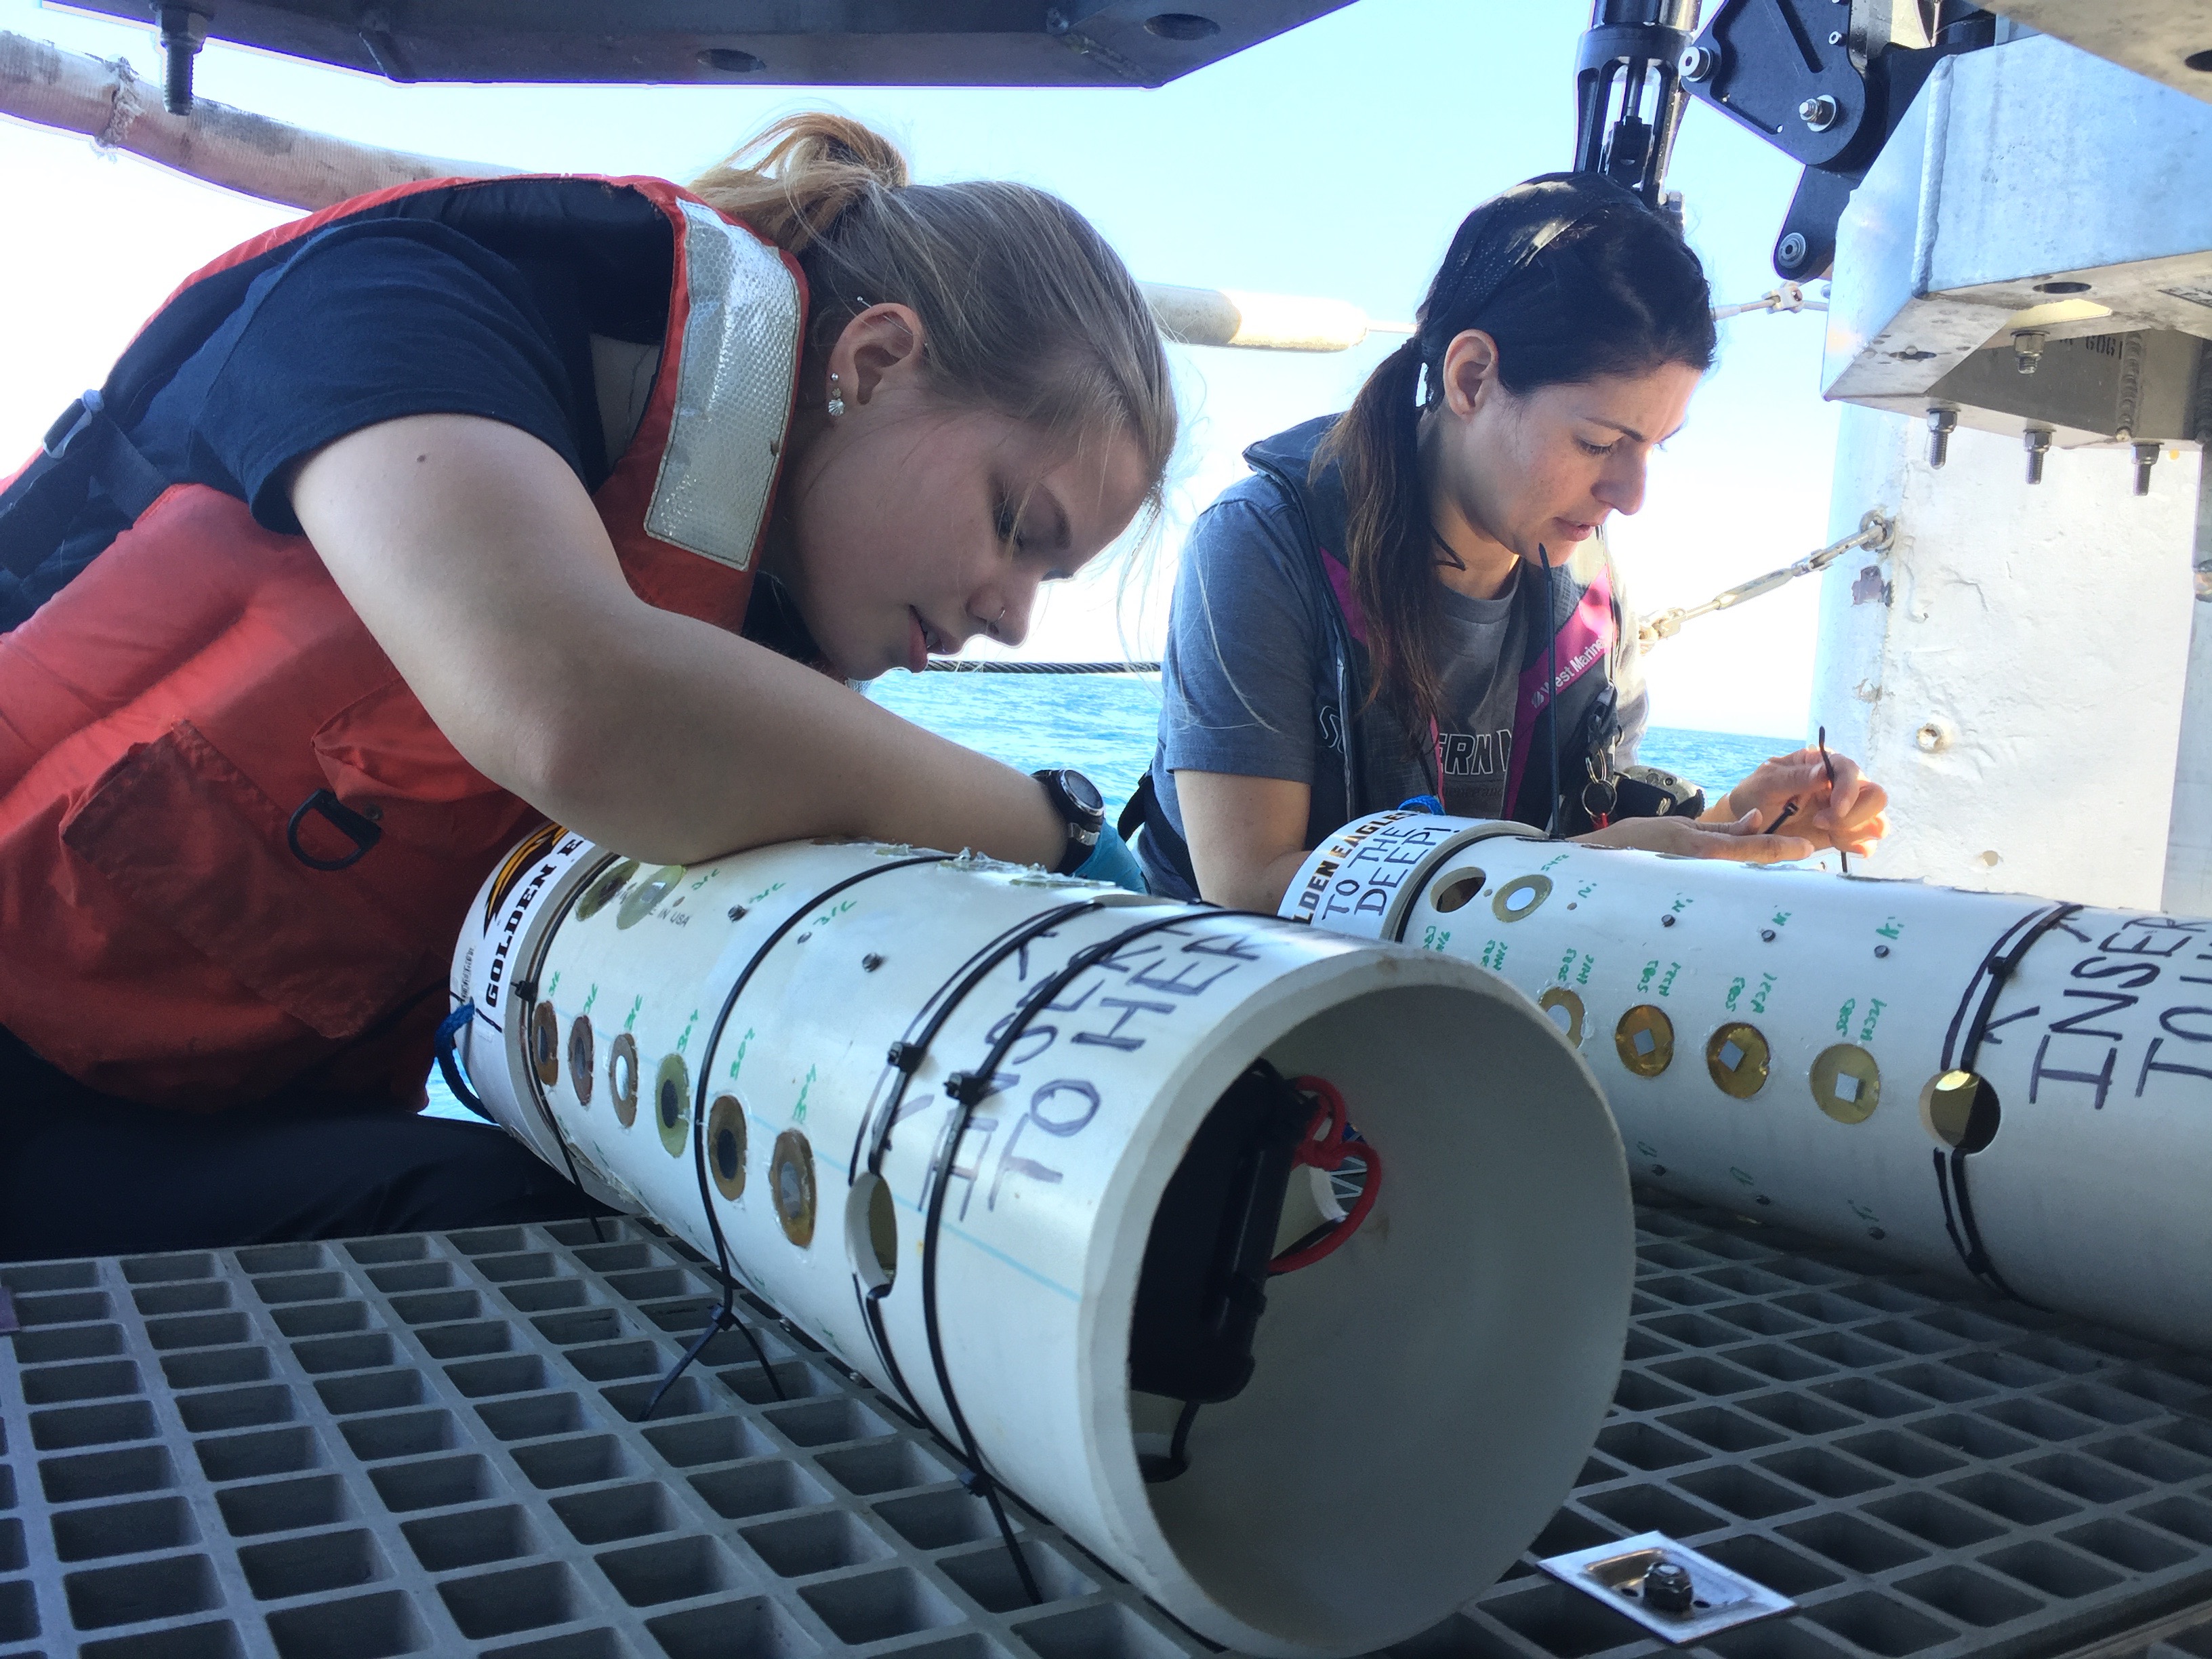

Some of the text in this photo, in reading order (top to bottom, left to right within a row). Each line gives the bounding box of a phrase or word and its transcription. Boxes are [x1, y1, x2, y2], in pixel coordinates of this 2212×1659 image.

[1570, 638, 1605, 673] Marine
[1321, 826, 1417, 920] TO THE
[1328, 812, 1418, 859] EAGLES
[1354, 827, 1460, 916] DEEP!
[485, 863, 557, 1008] GOLDEN
[670, 912, 691, 928] USA
[989, 1078, 1101, 1212] TO
